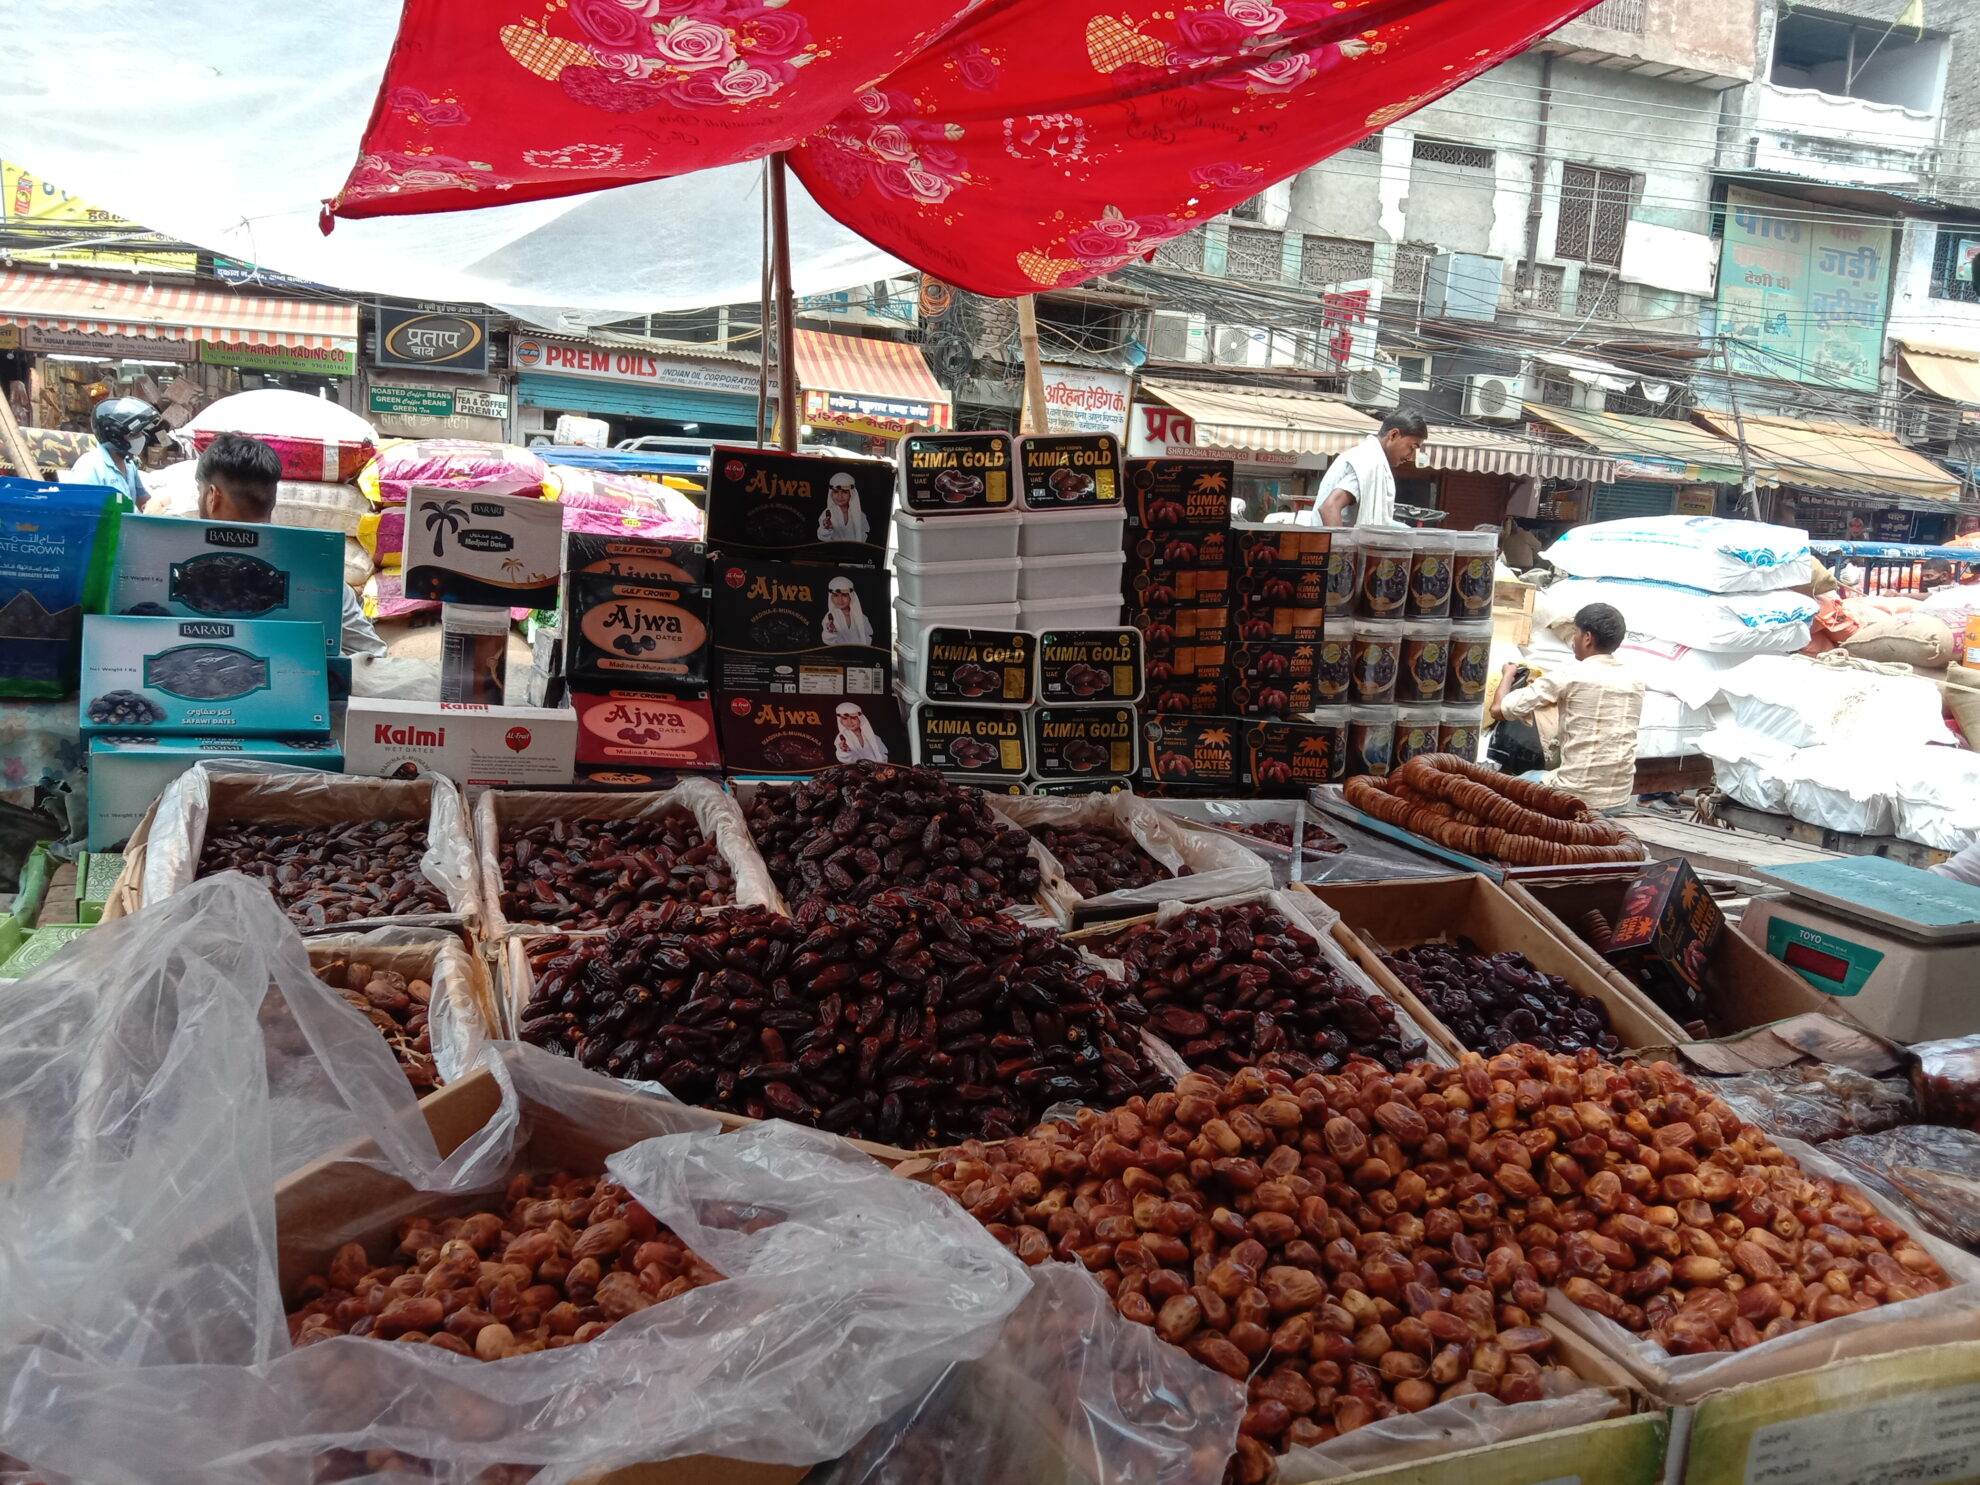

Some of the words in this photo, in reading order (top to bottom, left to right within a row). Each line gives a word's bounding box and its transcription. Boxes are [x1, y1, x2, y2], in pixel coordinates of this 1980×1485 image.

[406, 328, 460, 349] प्रताप
[285, 346, 327, 361] TRADING
[331, 349, 348, 363] CO.
[410, 345, 435, 357] चाय
[546, 345, 610, 372] PREM
[617, 354, 657, 377] OILS
[662, 368, 690, 378] INDIAN
[690, 371, 701, 380] OIL
[371, 387, 405, 396] ROASTED
[427, 391, 451, 400] BEANS
[1044, 381, 1086, 407] अरिहन्त
[1086, 385, 1113, 411] ट्रेडिंग
[376, 395, 401, 403] GREEN
[422, 399, 447, 407] BEANS
[457, 396, 471, 405] TEA
[480, 399, 507, 410] COFFEE
[393, 405, 417, 413] GREEN
[460, 405, 502, 417] PREMIX
[912, 452, 958, 468] KIMIA
[962, 451, 1005, 467] GOLD
[1028, 451, 1070, 467] KIMIA
[1073, 450, 1112, 466] GOLD
[1167, 447, 1183, 456] SHRI
[1184, 448, 1208, 457] RADHA
[1208, 450, 1237, 460] TRADING
[745, 469, 812, 499] Ajwa
[1187, 494, 1228, 506] KIMIA
[1186, 506, 1225, 516] DATES
[209, 530, 256, 544] BARARI
[464, 538, 489, 547] Medjool
[490, 540, 507, 549] Dates
[20, 544, 65, 555] CROWN
[635, 546, 664, 554] CROWN
[621, 587, 642, 595] GULF
[643, 589, 671, 598] CROWN
[746, 575, 813, 605] Ajwa
[603, 604, 682, 634] Ajwa
[183, 625, 231, 636] BARARI
[655, 634, 683, 642] DATES
[932, 645, 978, 662] KIMIA
[983, 648, 1025, 664] GOLD
[1044, 646, 1087, 662] KIMIA
[1092, 646, 1131, 662] GOLD
[640, 692, 668, 700] CROWN
[440, 703, 489, 711] Kalmi
[604, 704, 685, 728] Ajwa
[754, 704, 822, 729] Ajwa
[926, 719, 971, 735] KIMIA
[976, 721, 1017, 736] GOLD
[1042, 722, 1086, 738] KIMIA
[1089, 722, 1129, 738] GOLD
[374, 724, 446, 747] Kalmi
[1194, 748, 1233, 760] KIMIA
[1195, 759, 1231, 770] DATES
[1292, 756, 1329, 768] KIMIA
[1292, 767, 1327, 778] DATES
[1799, 929, 1822, 944] TOYO
